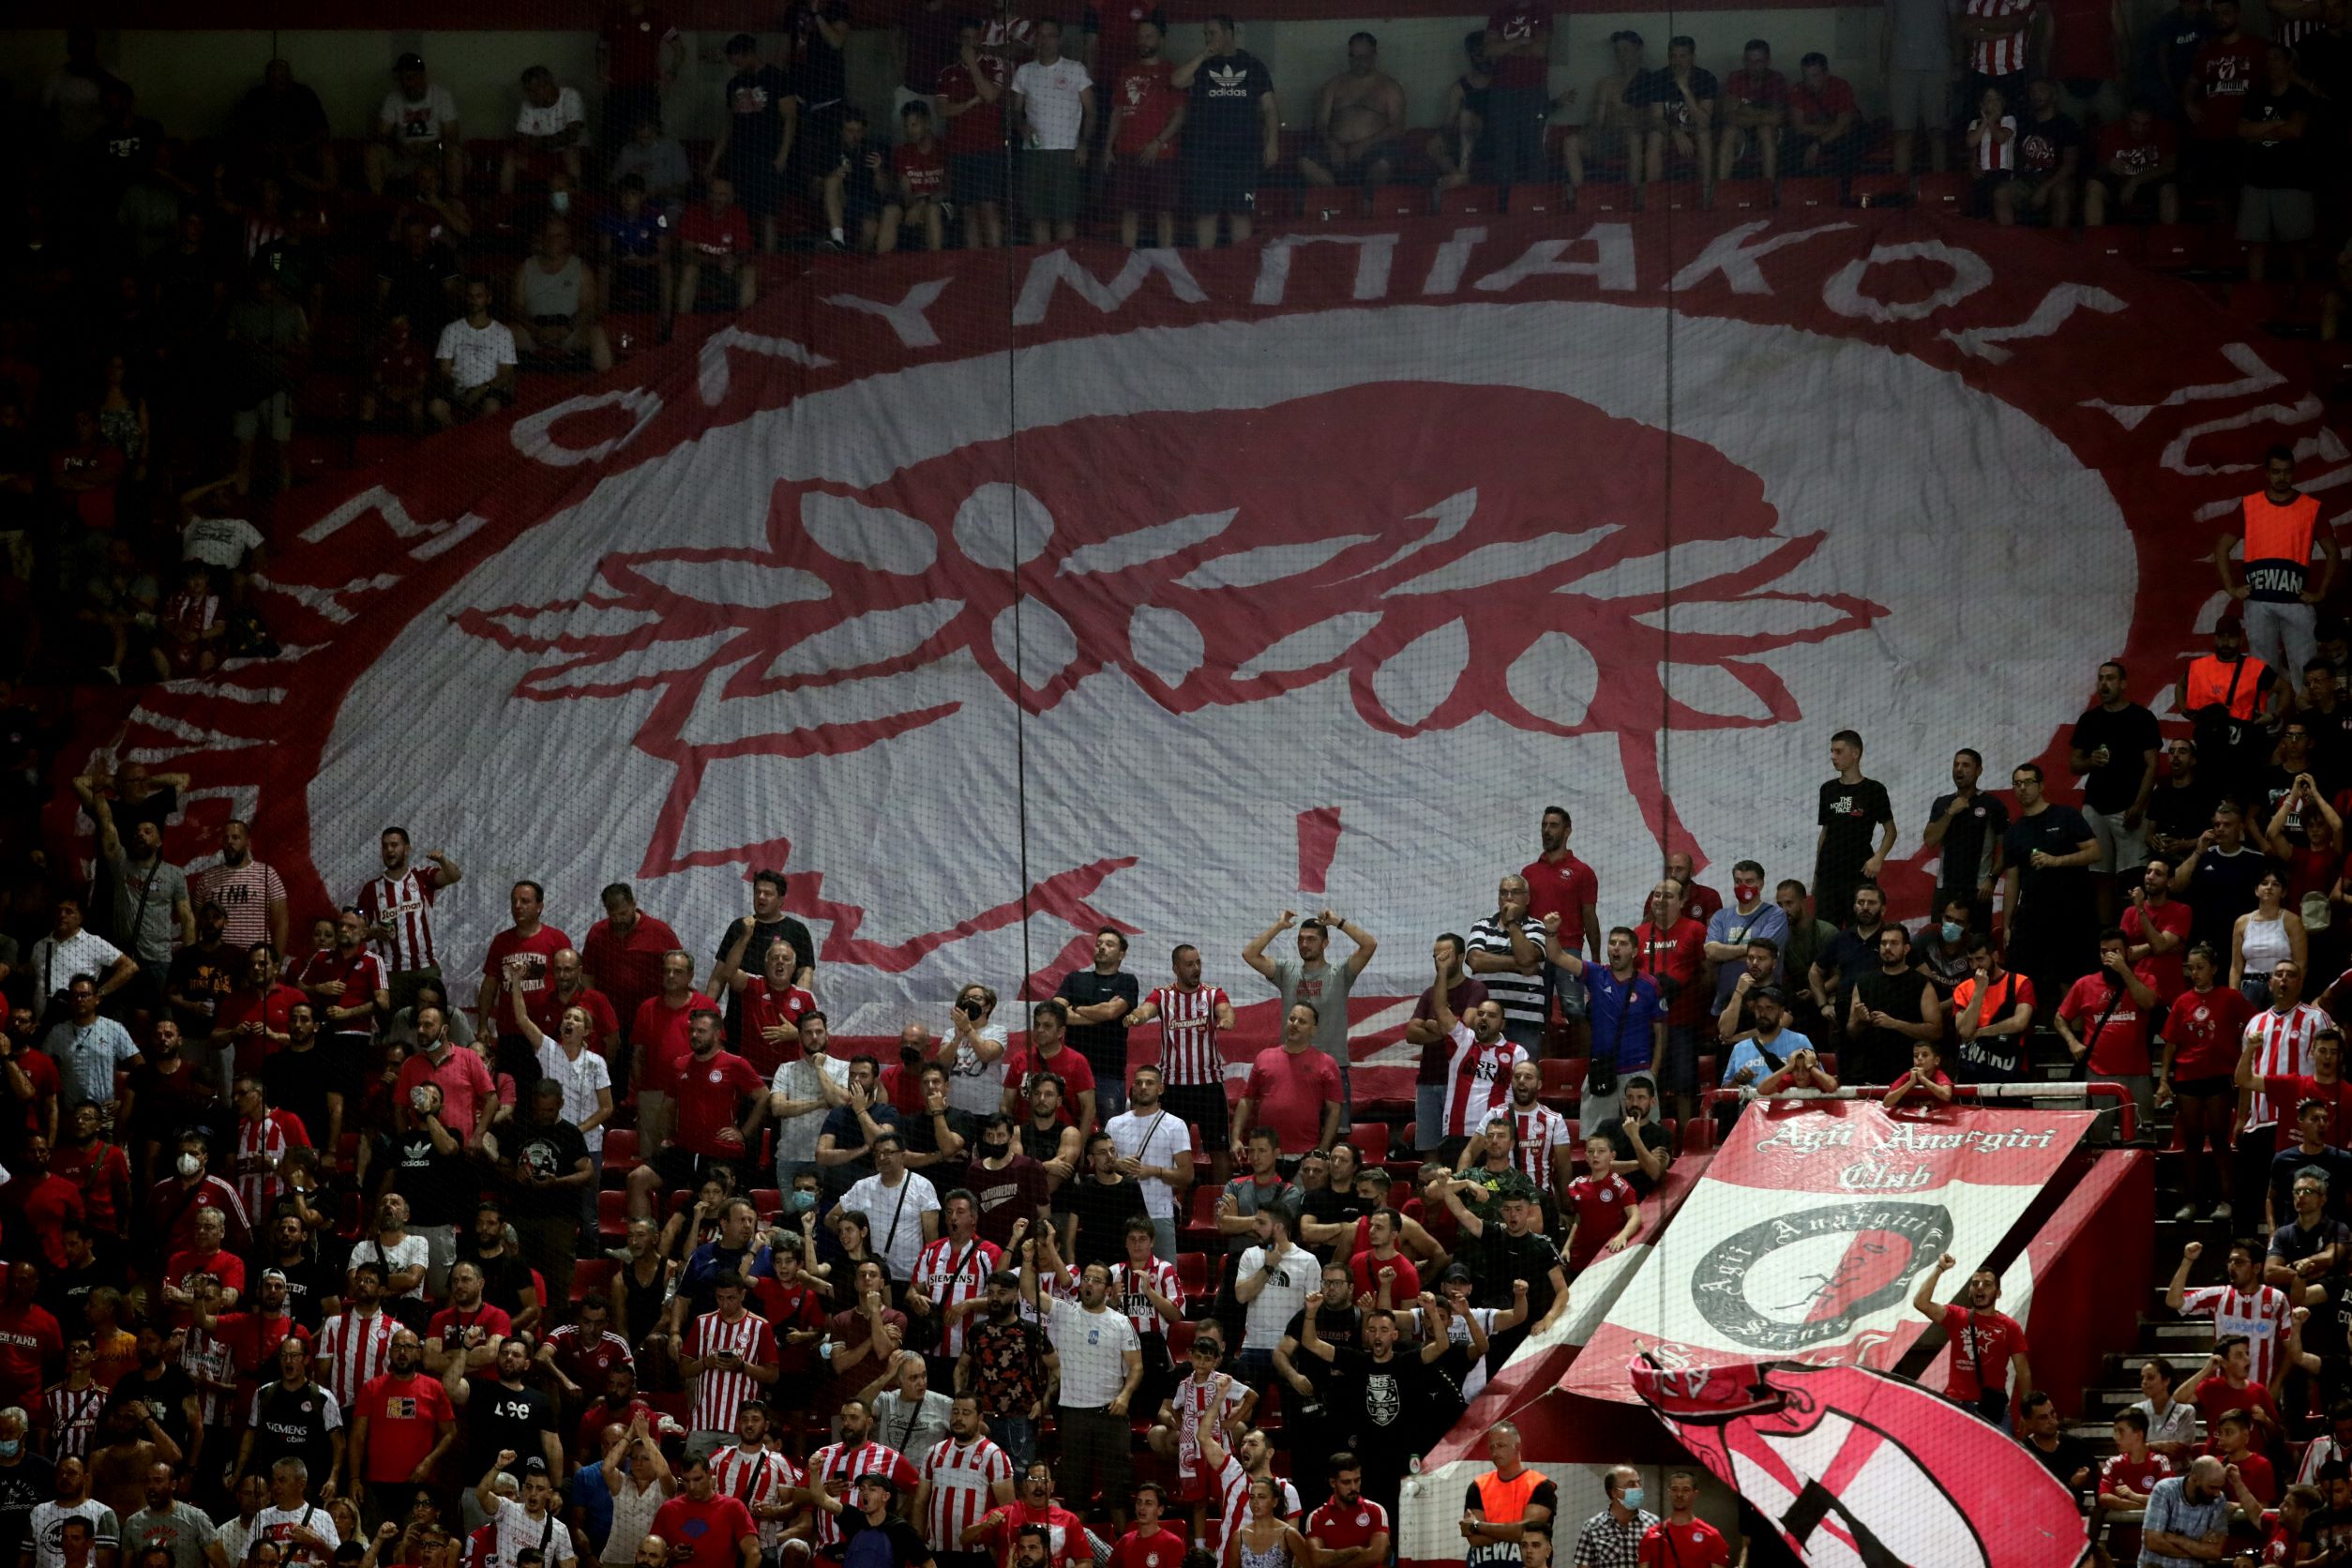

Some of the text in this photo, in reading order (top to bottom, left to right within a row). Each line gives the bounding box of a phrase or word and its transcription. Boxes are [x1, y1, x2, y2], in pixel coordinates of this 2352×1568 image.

[2246, 568, 2304, 595] TEWA
[1830, 802, 1852, 810] NORTH
[1645, 939, 1678, 950] TMMY
[400, 1159, 430, 1168] adidas
[1838, 1159, 1931, 1190] Club
[493, 1400, 530, 1420] Lee
[266, 1422, 308, 1436] SIEMENS
[285, 1435, 307, 1443] obile
[1470, 1541, 1523, 1568] TEWA
